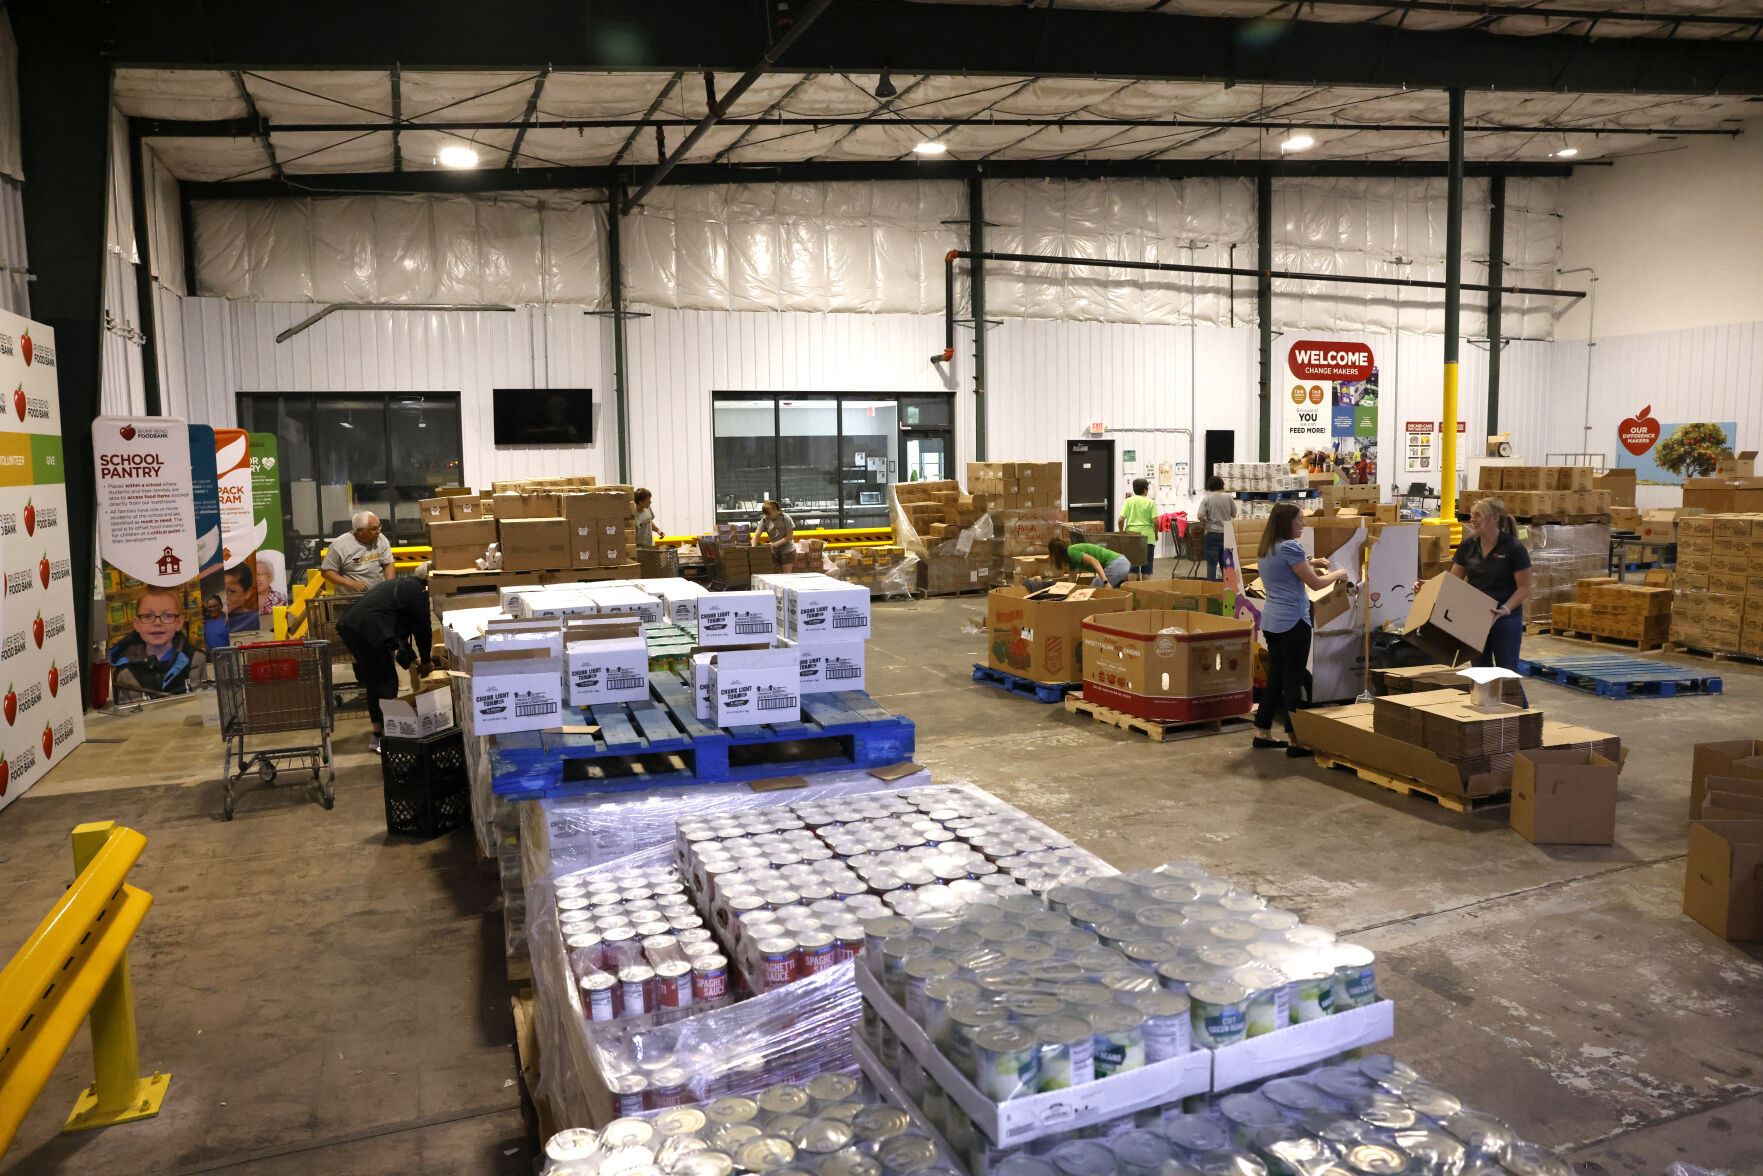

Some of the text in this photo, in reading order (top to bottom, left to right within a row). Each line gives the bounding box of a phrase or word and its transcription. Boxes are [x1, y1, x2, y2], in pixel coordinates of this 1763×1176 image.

[1294, 349, 1369, 366] WELCOME
[1305, 367, 1332, 375] CHANGE
[1298, 413, 1318, 422] YOU
[1092, 423, 1103, 433] EXIT
[100, 453, 164, 466] SCHOOL
[101, 466, 162, 479] PANTRY
[9, 579, 33, 595] FOOD BANK
[14, 641, 27, 655] BANK
[1123, 648, 1141, 656] ONIONS
[572, 669, 588, 677] CHUNK
[720, 687, 738, 695] CHUNK
[738, 685, 752, 693] LIGHT
[19, 692, 42, 713] FOOD BANK
[476, 694, 494, 703] CHUNK
[495, 692, 510, 700] LIGHT
[10, 756, 36, 782] FOOD BANK
[703, 985, 726, 997] SAUCE
[1222, 1016, 1236, 1025] CUT
